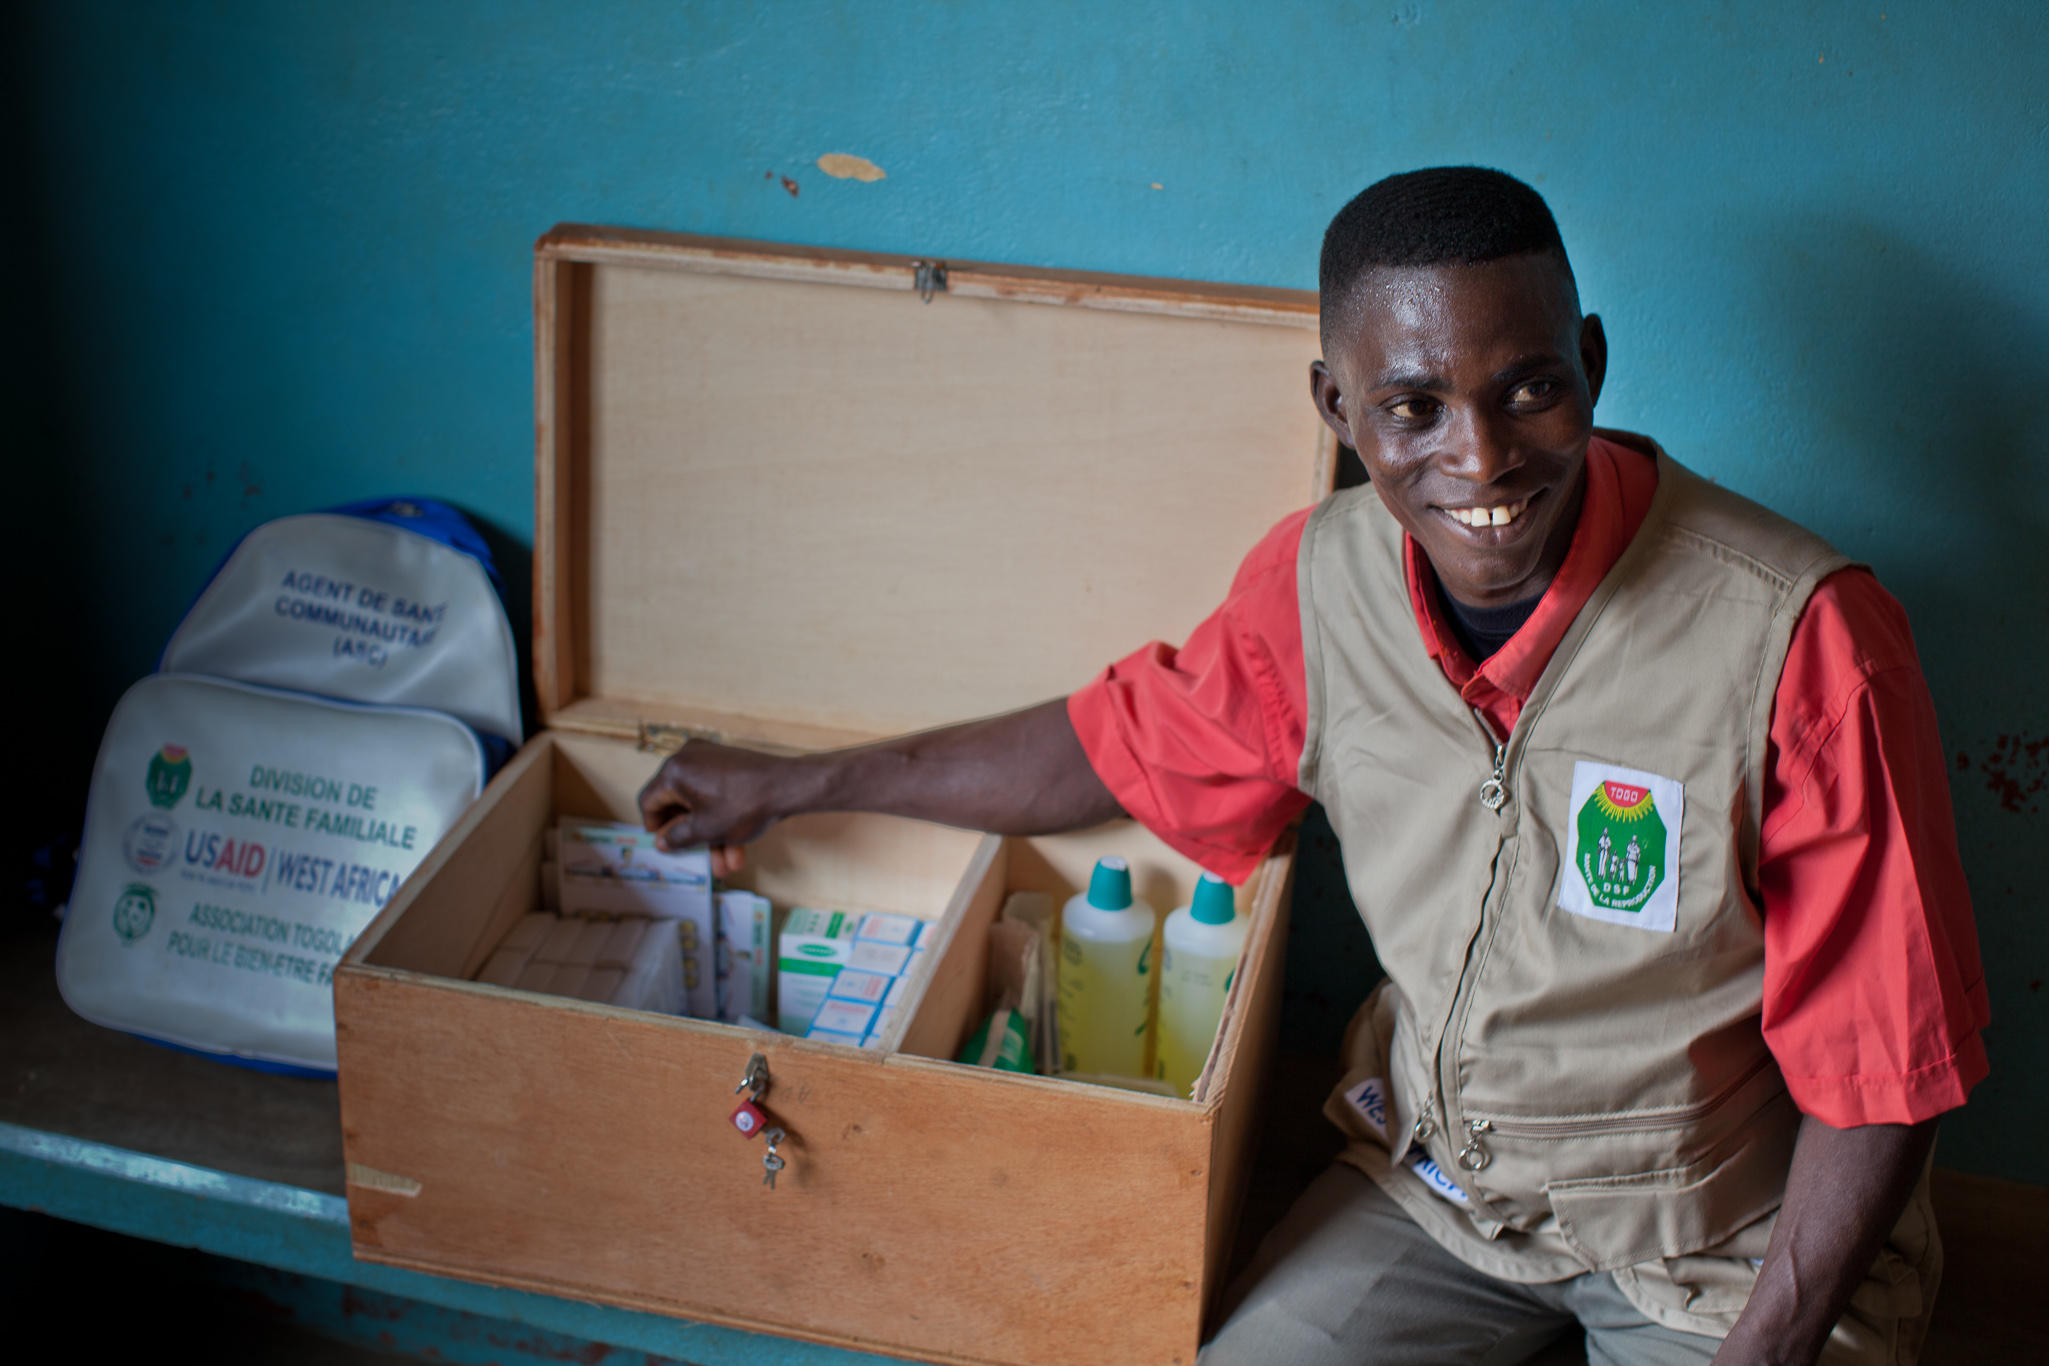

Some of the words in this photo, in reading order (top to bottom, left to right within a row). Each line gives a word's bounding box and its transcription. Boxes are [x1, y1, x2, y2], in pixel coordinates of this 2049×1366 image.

[282, 570, 354, 603] AGENT
[357, 586, 388, 613] DE
[250, 763, 343, 804] DIVISION
[347, 783, 379, 811] DE
[1610, 786, 1639, 803] TOGO
[195, 787, 223, 812] LA
[227, 791, 302, 829] SANTE
[303, 806, 418, 851] FAMILIALE
[184, 828, 266, 879] USAID
[277, 850, 334, 893] WEST
[1599, 893, 1610, 906] LA
[188, 901, 291, 945] ASSOCIATION
[167, 929, 212, 960] POUR
[212, 938, 232, 966] LE
